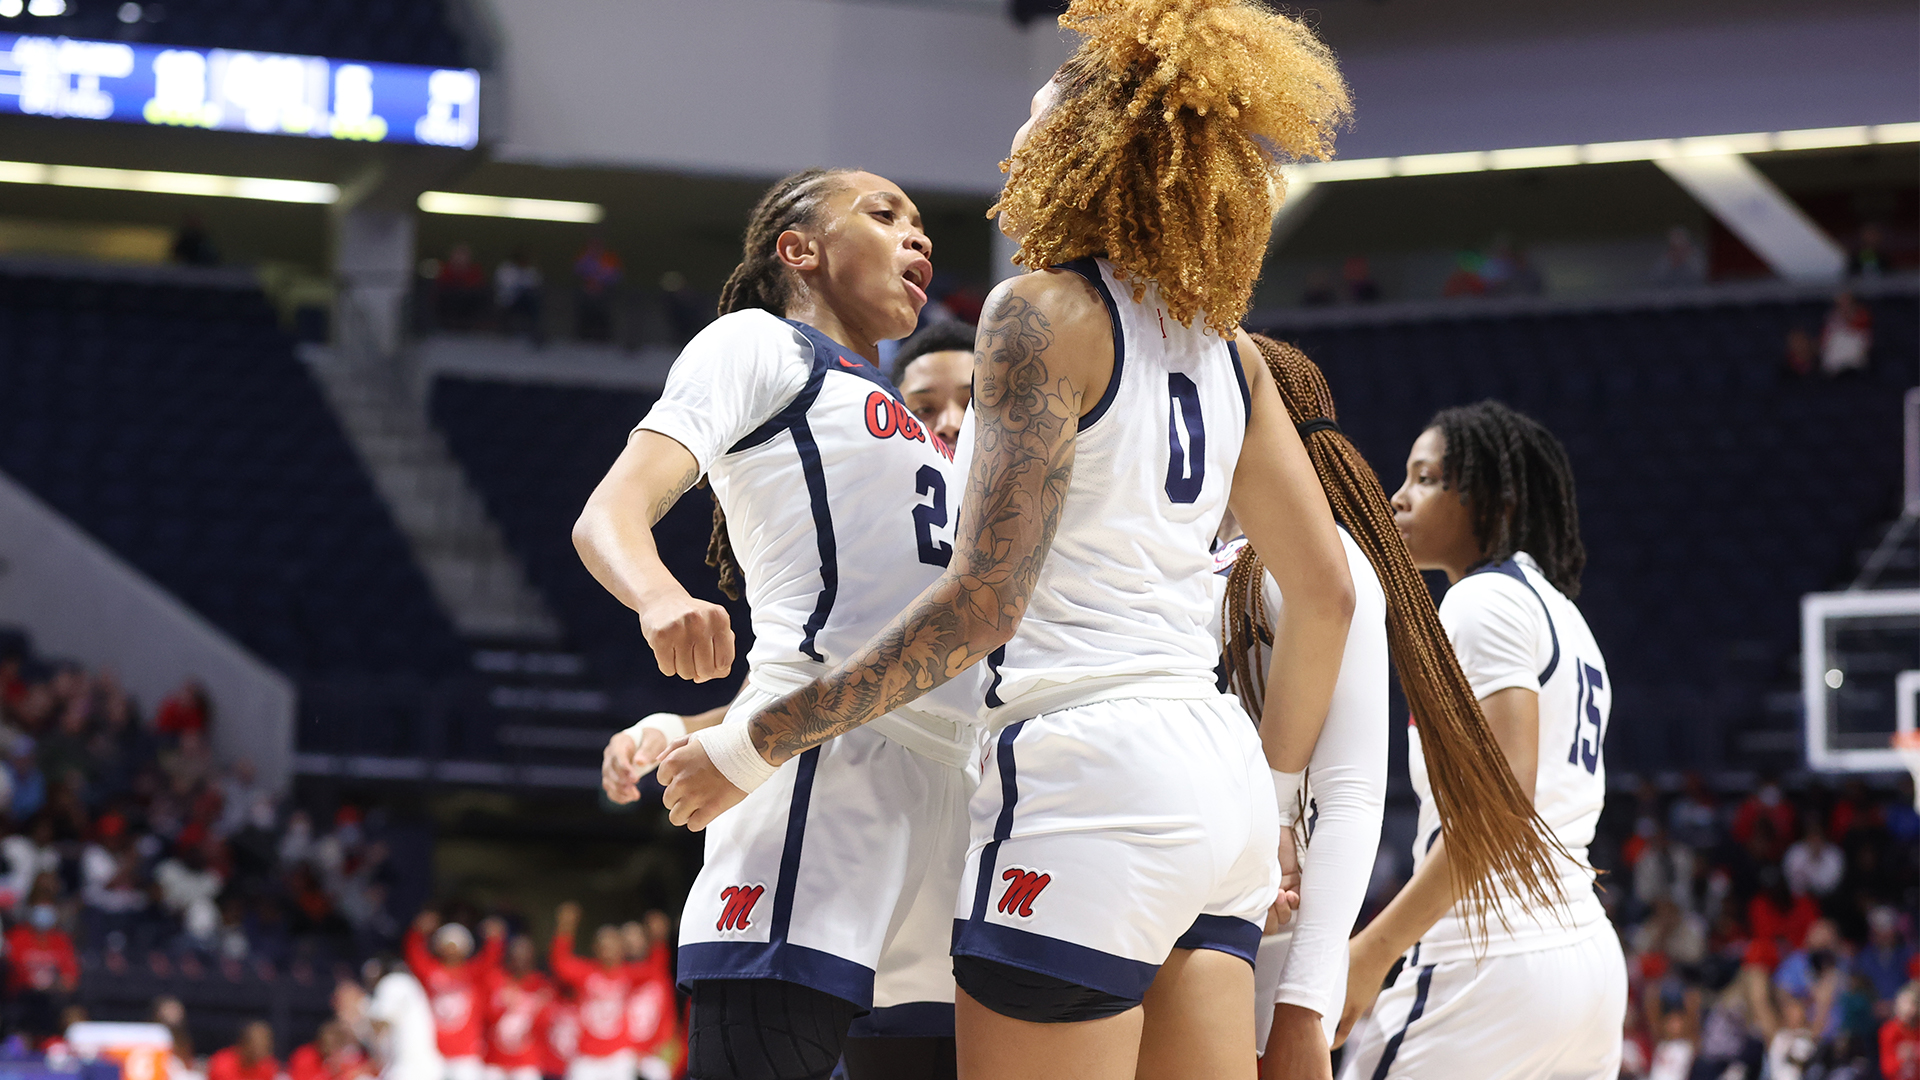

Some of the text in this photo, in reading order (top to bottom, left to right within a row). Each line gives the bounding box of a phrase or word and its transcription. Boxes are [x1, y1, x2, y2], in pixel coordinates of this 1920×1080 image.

[865, 391, 926, 444] Ole
[1164, 372, 1206, 504] 0
[911, 464, 961, 569] 2
[1568, 656, 1604, 776] 15
